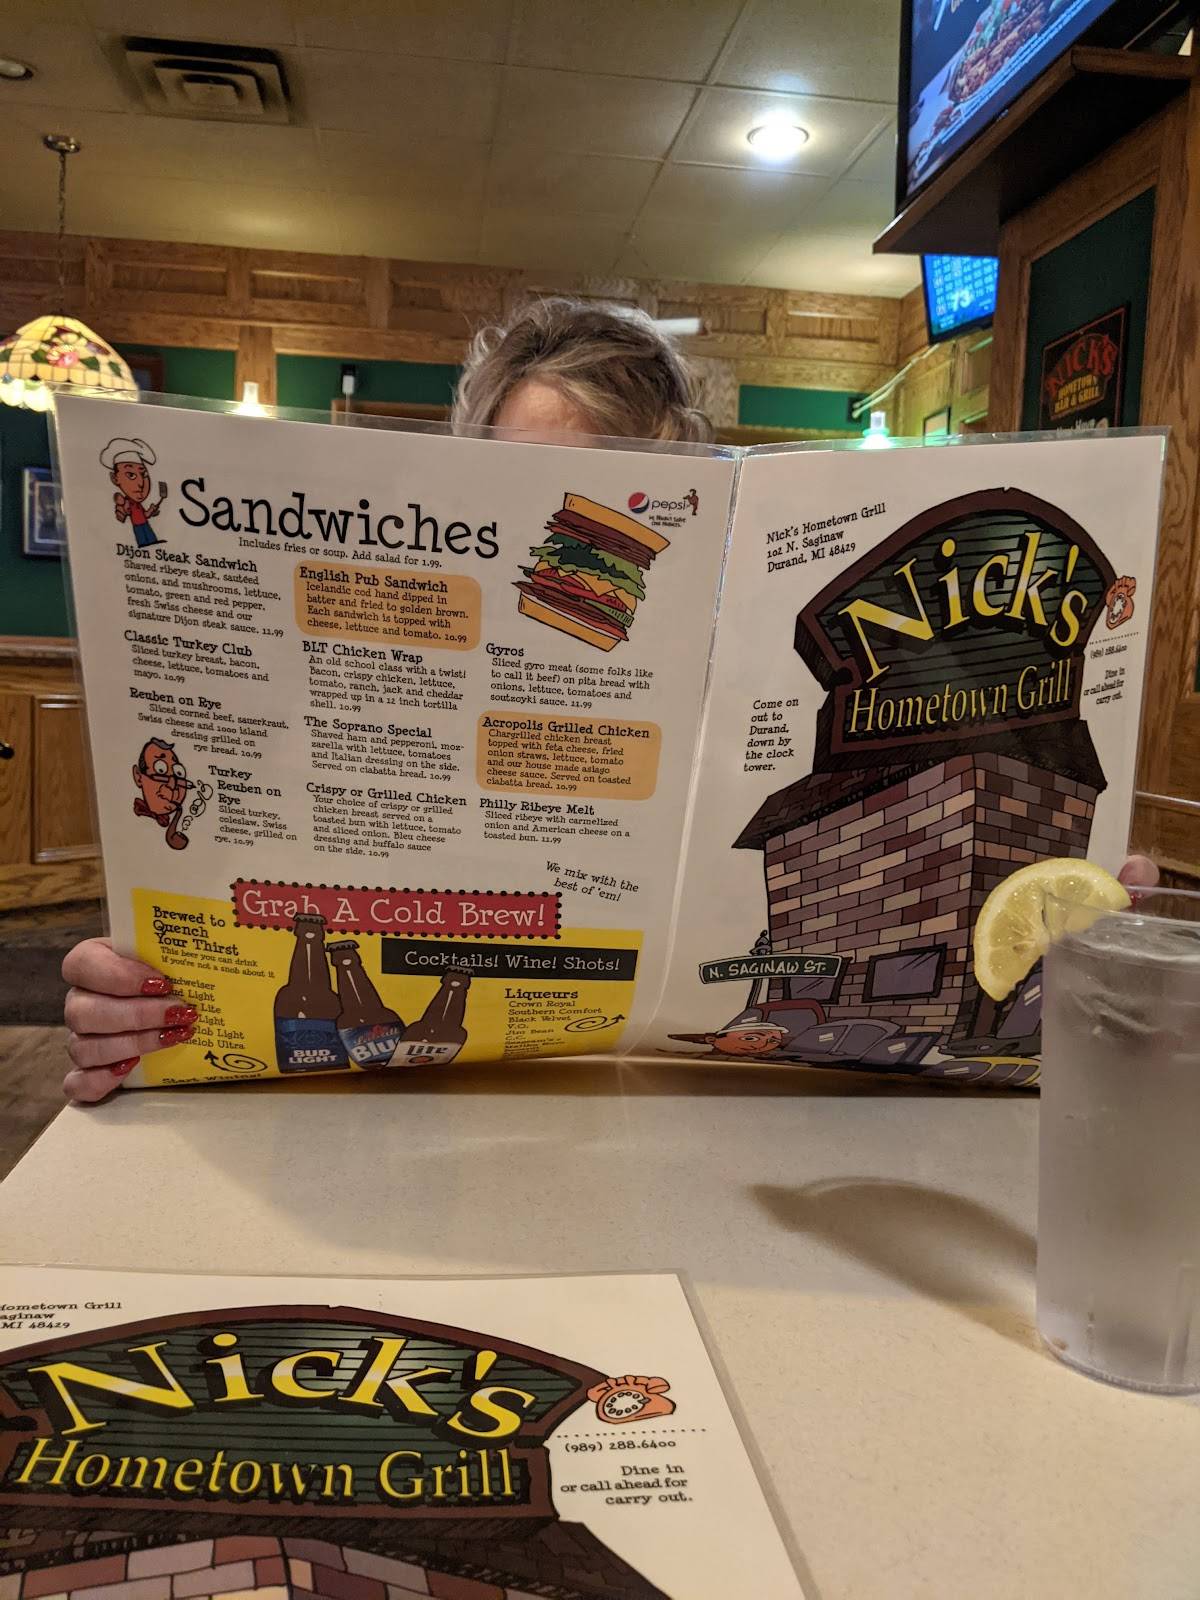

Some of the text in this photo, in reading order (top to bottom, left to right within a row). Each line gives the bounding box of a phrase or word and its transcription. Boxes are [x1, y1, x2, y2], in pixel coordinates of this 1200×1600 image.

[652, 498, 686, 510] pepsi
[179, 477, 499, 559] Sandwiches
[767, 502, 886, 544] Nick's Hometown Grill
[239, 536, 442, 568] Includes fries or soup. Add salad for 1.99.
[767, 530, 844, 558] 102 N. Saginaw
[117, 544, 257, 572] Dijon Steak Sandwich
[767, 541, 855, 573] Durand, MI 48429
[300, 567, 447, 593] English Pub Sandwich
[306, 582, 447, 604] Icelandic cod hand dipped in
[307, 594, 468, 618] batter and fried to golden brown.
[838, 532, 1088, 684] Nick's
[124, 630, 252, 657] Classic Turkey Club
[302, 641, 423, 664] BLT Chicken Wrap
[486, 643, 525, 657] Gyros
[130, 687, 222, 710] Reuben on Rye
[753, 699, 799, 709] Come on
[849, 682, 1008, 735] Hometown
[1017, 658, 1072, 713] Grill
[751, 712, 782, 722] out to
[304, 716, 432, 738] The Soprano Special
[482, 717, 650, 739] Acropolis Grilled Chicken
[747, 737, 792, 747] down by
[745, 748, 794, 760] the clock
[208, 765, 253, 780] Turkey
[743, 763, 776, 772] tower.
[217, 780, 281, 797] Reuben on
[307, 782, 467, 806] Crispy or Grilled Chicken
[218, 793, 240, 805] Rye
[480, 798, 595, 816] Philly Ribeye Melt
[546, 861, 639, 893] We mix with the
[554, 878, 578, 890] best
[581, 885, 595, 895] of
[153, 906, 225, 928] Brewed to
[242, 890, 545, 927] Grab A Cold Brew!
[153, 920, 209, 939] Quench
[156, 932, 239, 956] Your Thirst
[161, 946, 178, 955] This
[235, 958, 258, 967] drink
[405, 951, 620, 971] Cocktails! Wine! Shots!
[198, 961, 211, 969] not
[221, 965, 240, 974] snob
[242, 968, 265, 977] about
[709, 959, 826, 979] N. SAGINAW ST.
[188, 990, 215, 1001] Light
[504, 988, 578, 1000] Liqueurs
[201, 1003, 221, 1013] Lite
[199, 1015, 225, 1026] Light
[218, 1029, 244, 1039] Light
[217, 1040, 245, 1049] Ultra
[352, 1037, 400, 1062] Blu
[405, 1045, 448, 1055] Lite
[289, 1049, 337, 1064] BUD LIGHT
[84, 1301, 122, 1310] Grill
[0, 1312, 55, 1320] aginaw
[1, 1321, 24, 1329] MI
[27, 1333, 535, 1438] Nick's
[564, 1439, 677, 1454] (989) 288.6400
[15, 1437, 514, 1499] Hometown Grill
[621, 1463, 684, 1477] Dine in
[560, 1476, 688, 1493] or call ahead for
[605, 1492, 693, 1506] carry out.
